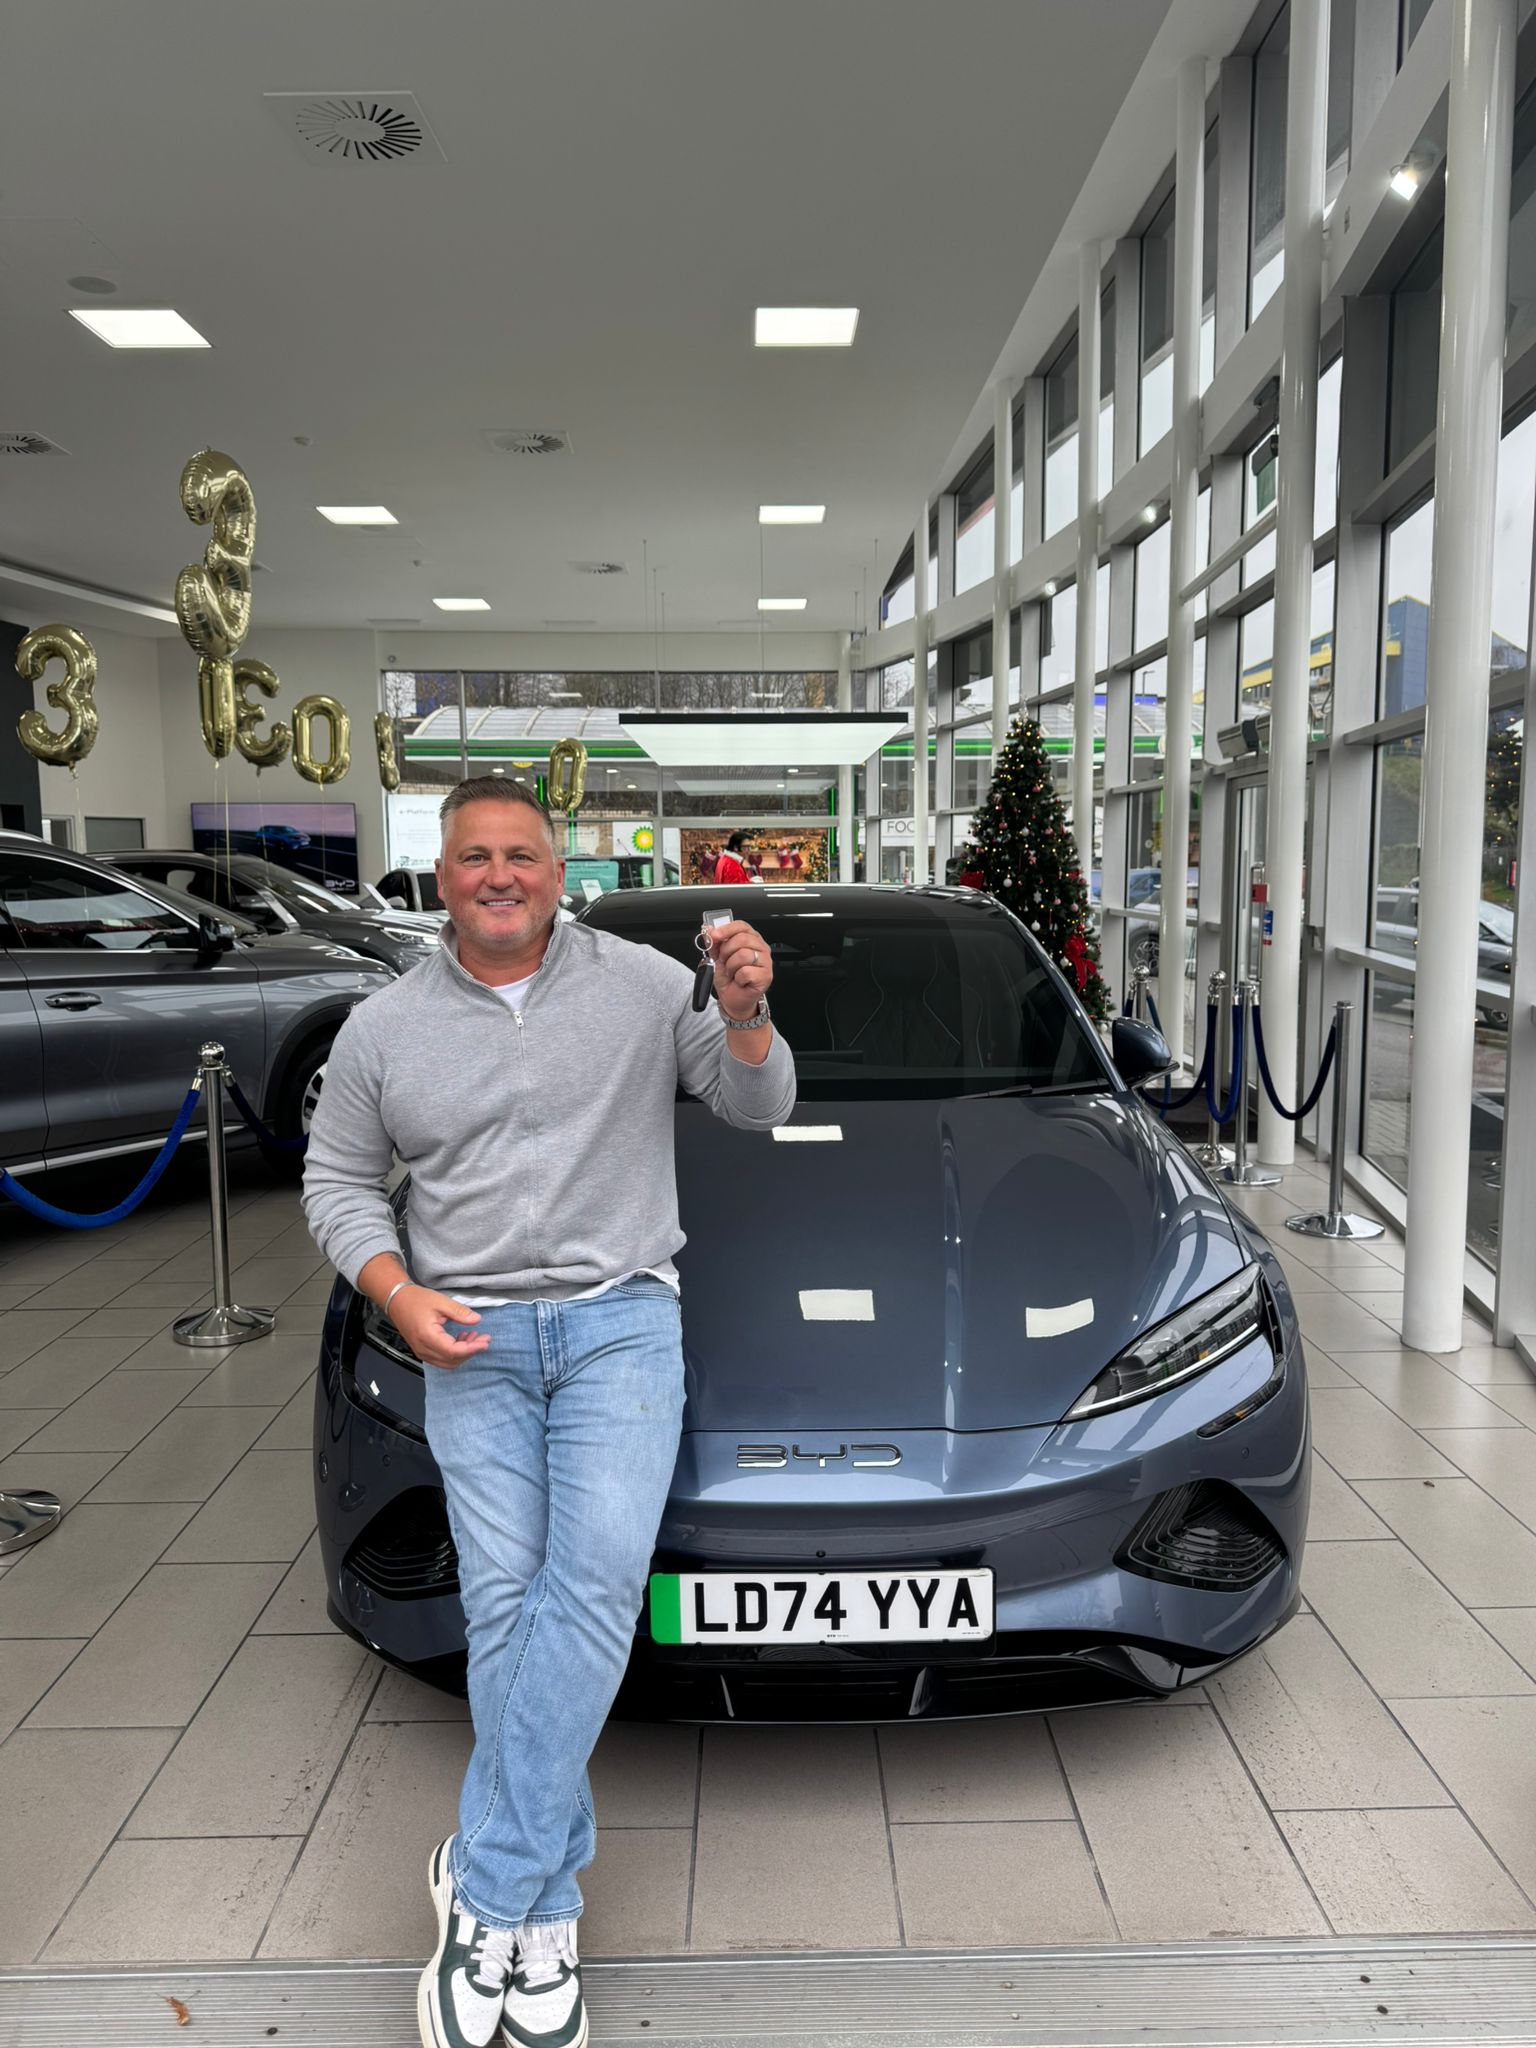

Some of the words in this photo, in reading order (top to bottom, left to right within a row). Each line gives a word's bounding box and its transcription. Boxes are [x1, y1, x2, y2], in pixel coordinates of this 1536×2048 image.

[15, 623, 99, 767] 3
[547, 737, 588, 812] 0
[326, 879, 356, 888] BYD
[736, 1443, 904, 1469] BYD
[694, 1580, 847, 1633] LD74
[867, 1577, 980, 1630] YYA
